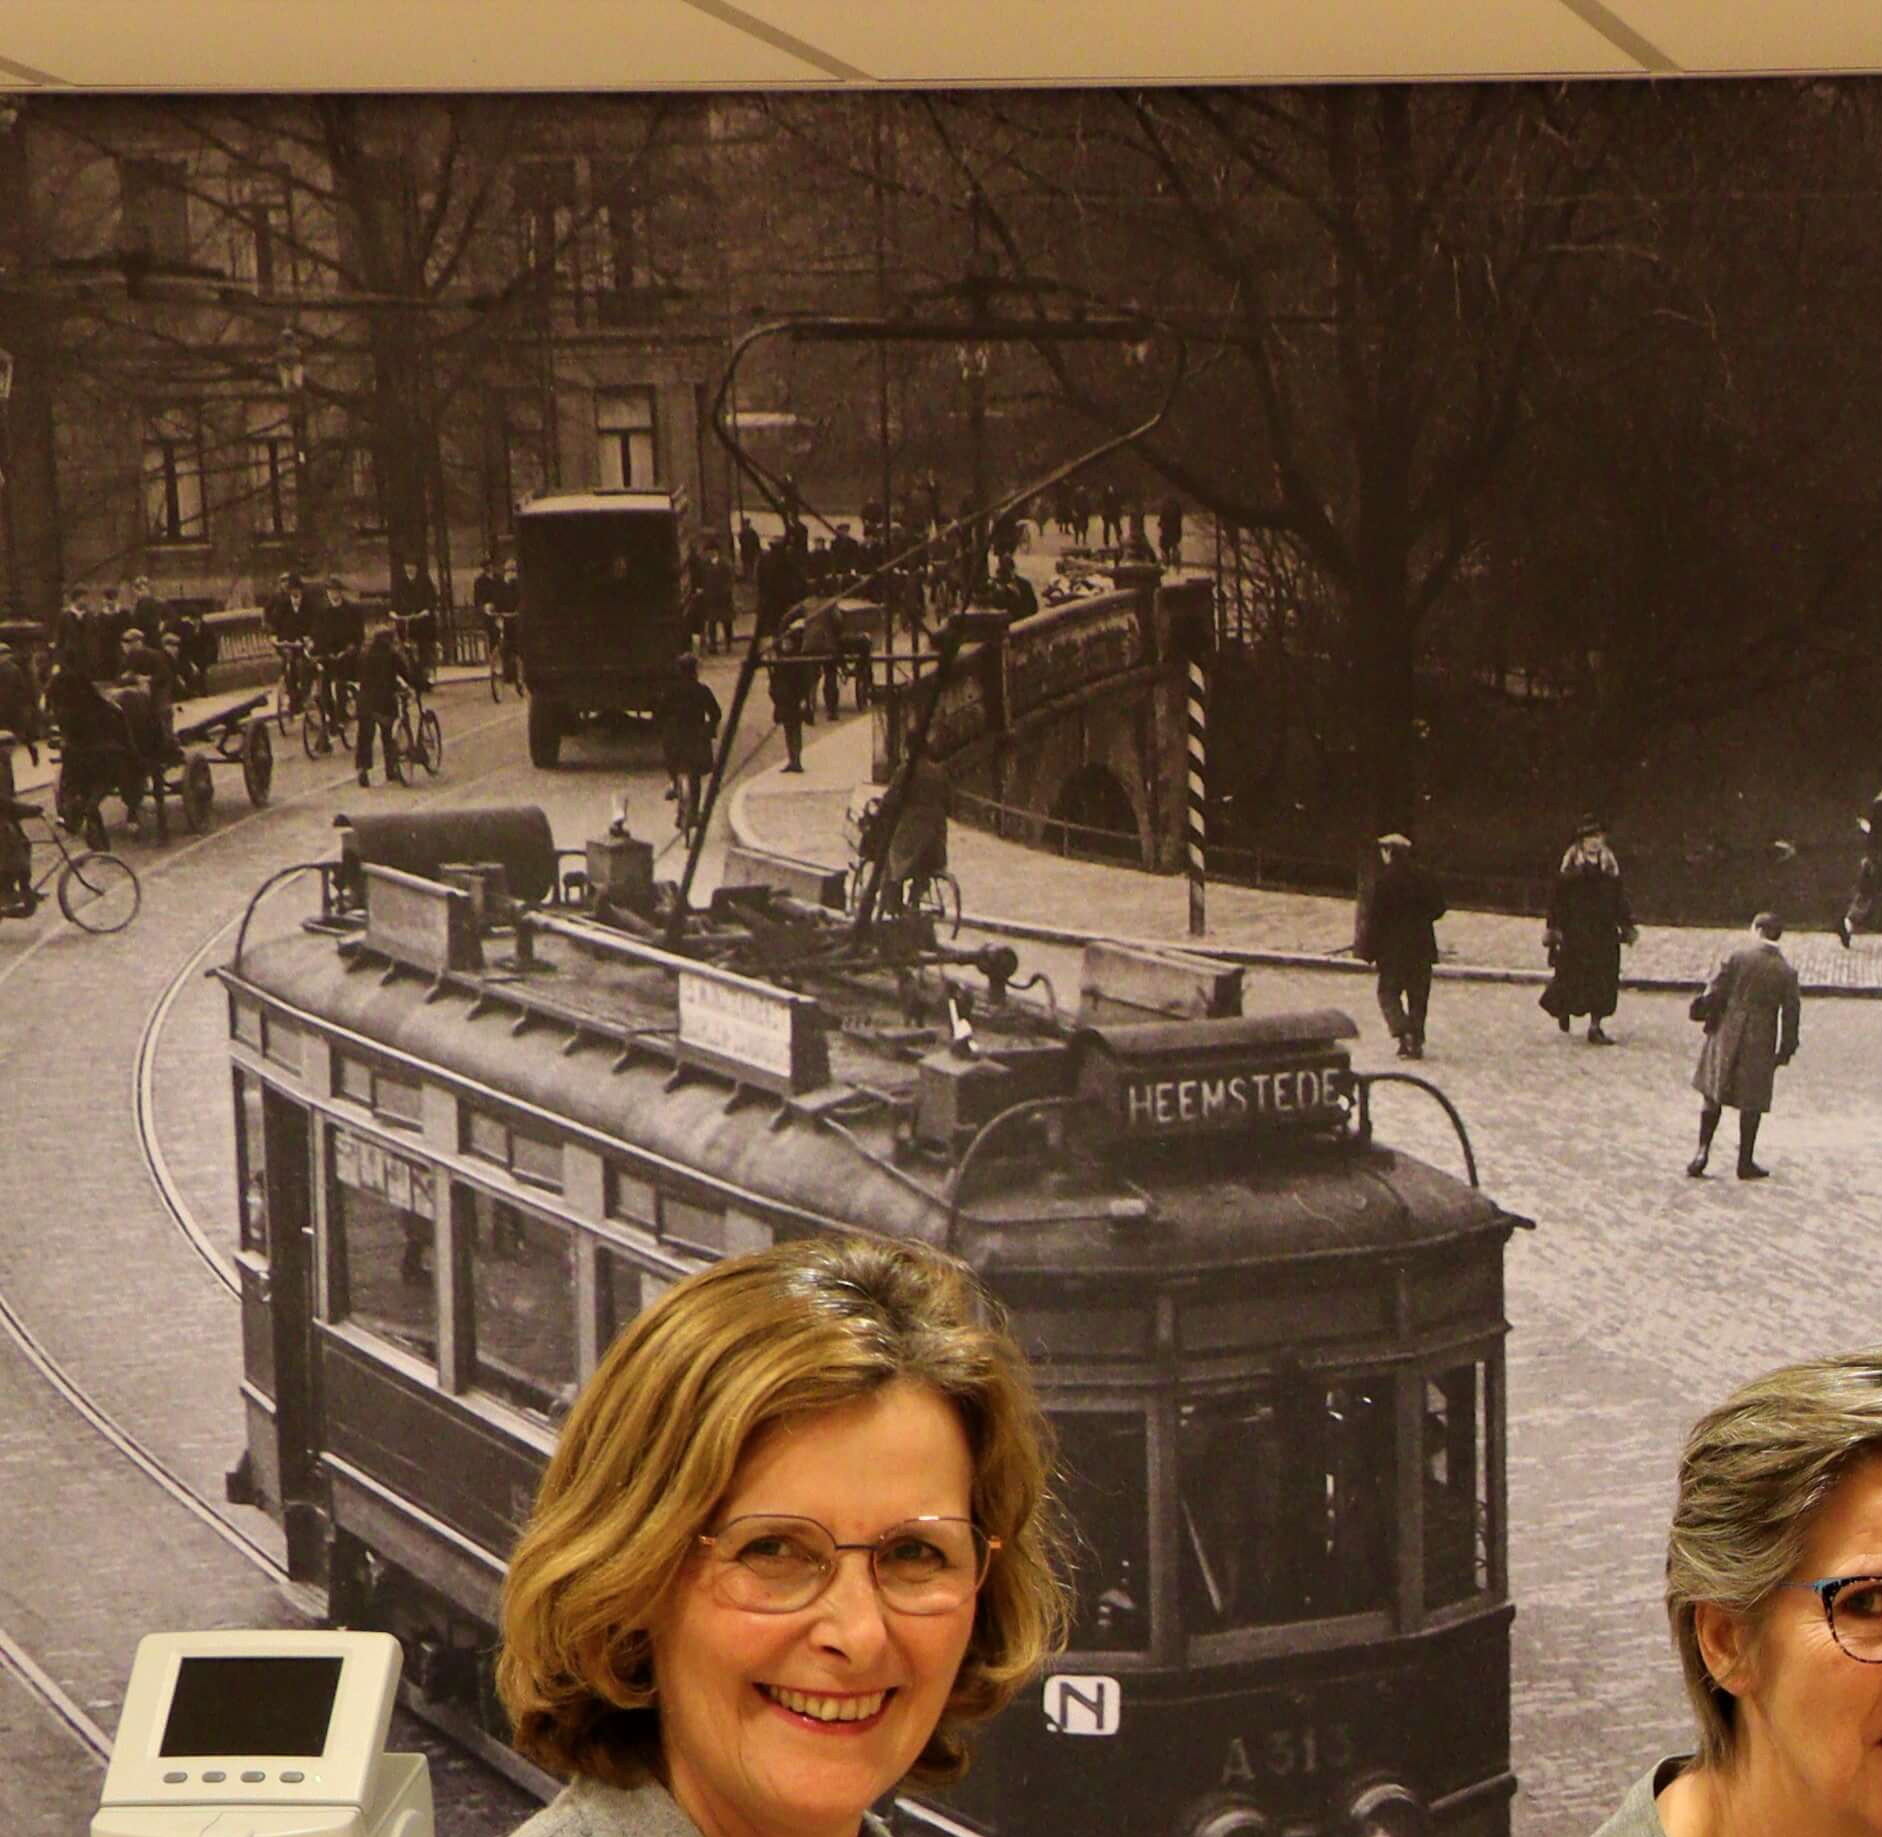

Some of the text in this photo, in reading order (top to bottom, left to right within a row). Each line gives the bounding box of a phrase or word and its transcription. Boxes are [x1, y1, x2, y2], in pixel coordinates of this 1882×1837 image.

[1129, 1068, 1340, 1126] HEEMSTEDE
[1060, 1682, 1105, 1730] N
[1220, 1737, 1255, 1784] A
